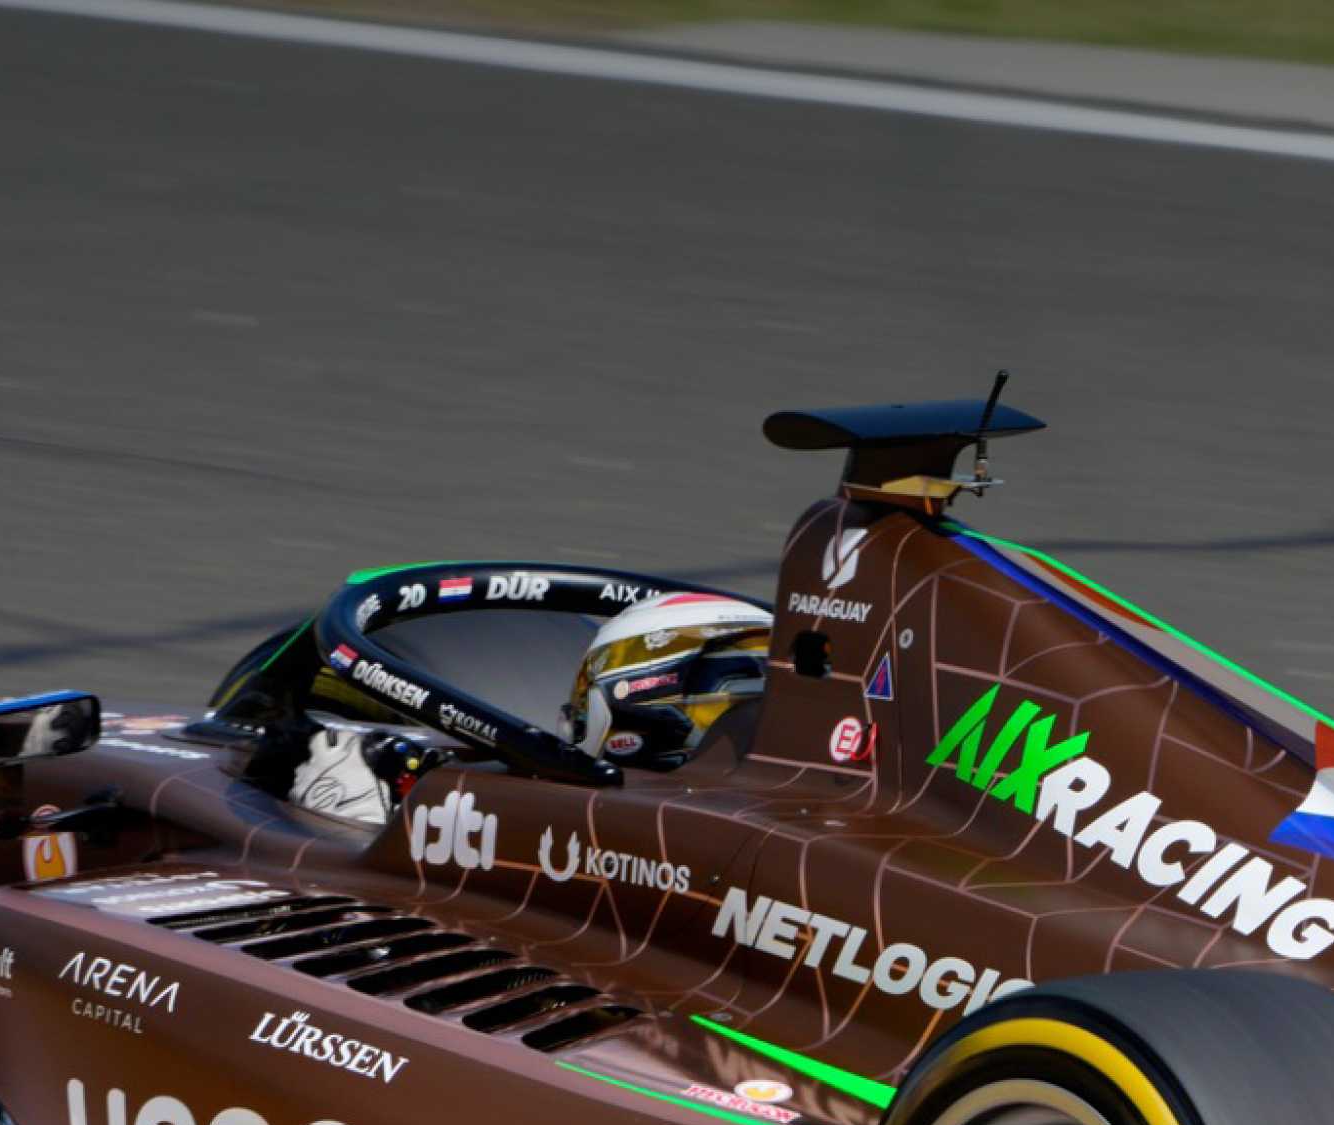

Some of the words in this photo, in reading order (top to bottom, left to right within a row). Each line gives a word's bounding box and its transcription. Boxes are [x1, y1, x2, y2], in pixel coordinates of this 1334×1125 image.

[397, 583, 427, 612] 20
[787, 591, 874, 623] PARAGUAY
[352, 659, 431, 709] DÜRKSEN
[585, 847, 692, 895] KOTINOS
[58, 951, 181, 1015] ARENA
[71, 998, 144, 1035] CAPITAL
[249, 1009, 410, 1084] LÜRSSEN
